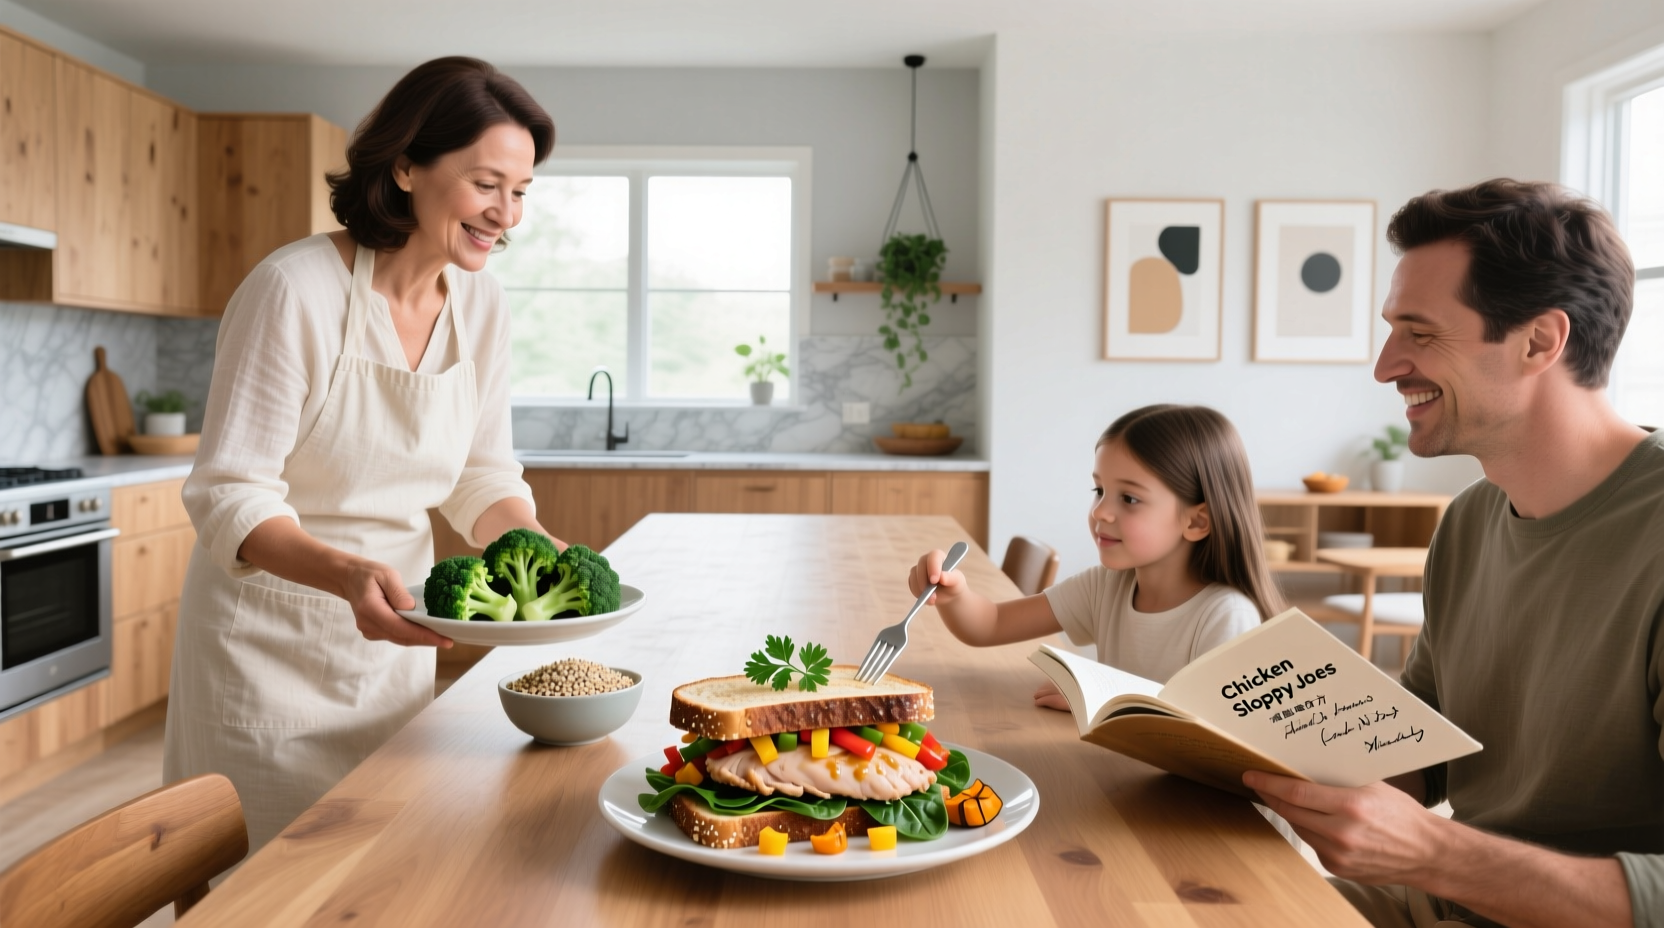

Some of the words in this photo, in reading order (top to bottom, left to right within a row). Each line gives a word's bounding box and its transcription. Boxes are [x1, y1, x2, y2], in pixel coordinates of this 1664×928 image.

[1221, 659, 1294, 699] Chicken
[1232, 681, 1294, 717] Sloppy
[1296, 662, 1337, 689] Joes
